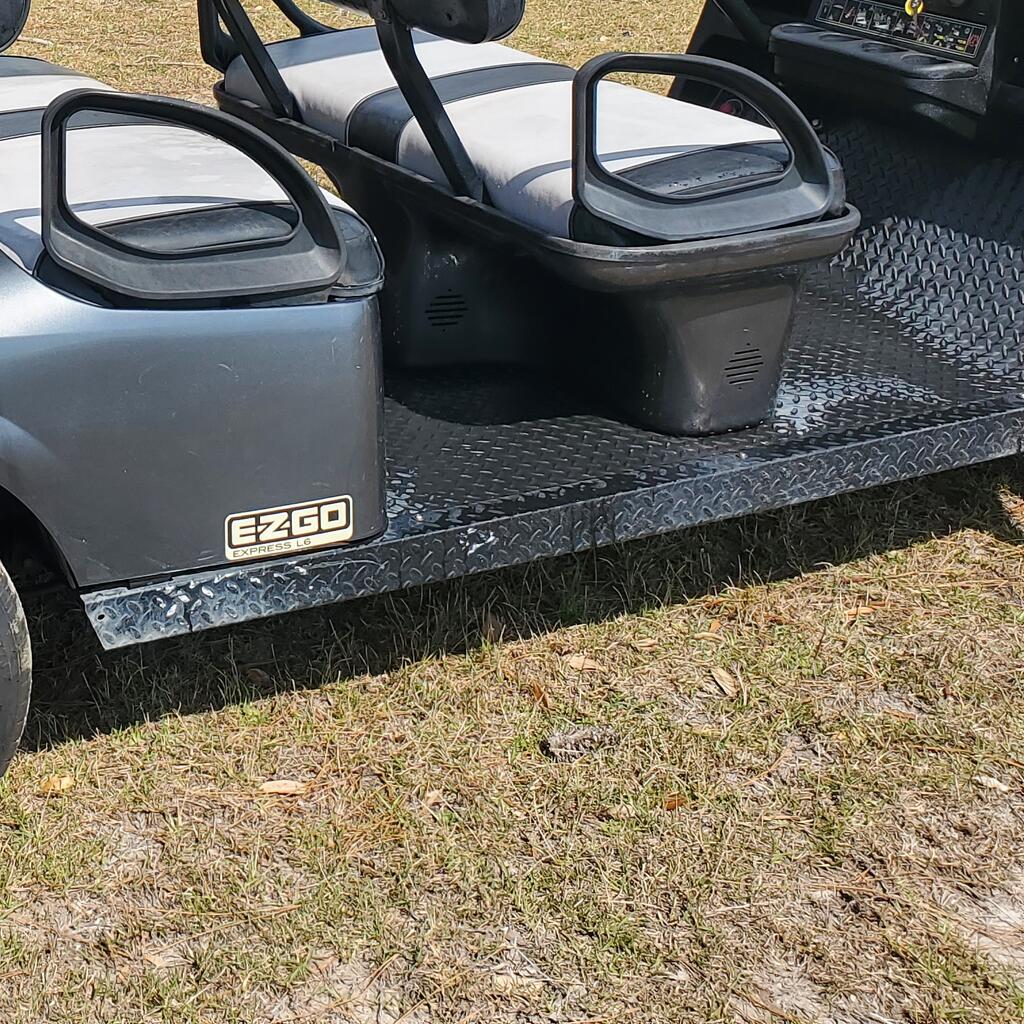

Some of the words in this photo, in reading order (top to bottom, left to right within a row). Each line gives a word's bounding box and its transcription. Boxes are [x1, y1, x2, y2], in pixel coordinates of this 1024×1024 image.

[231, 501, 347, 546] EZGO
[232, 541, 292, 558] EXPRESS
[296, 537, 312, 547] L6
